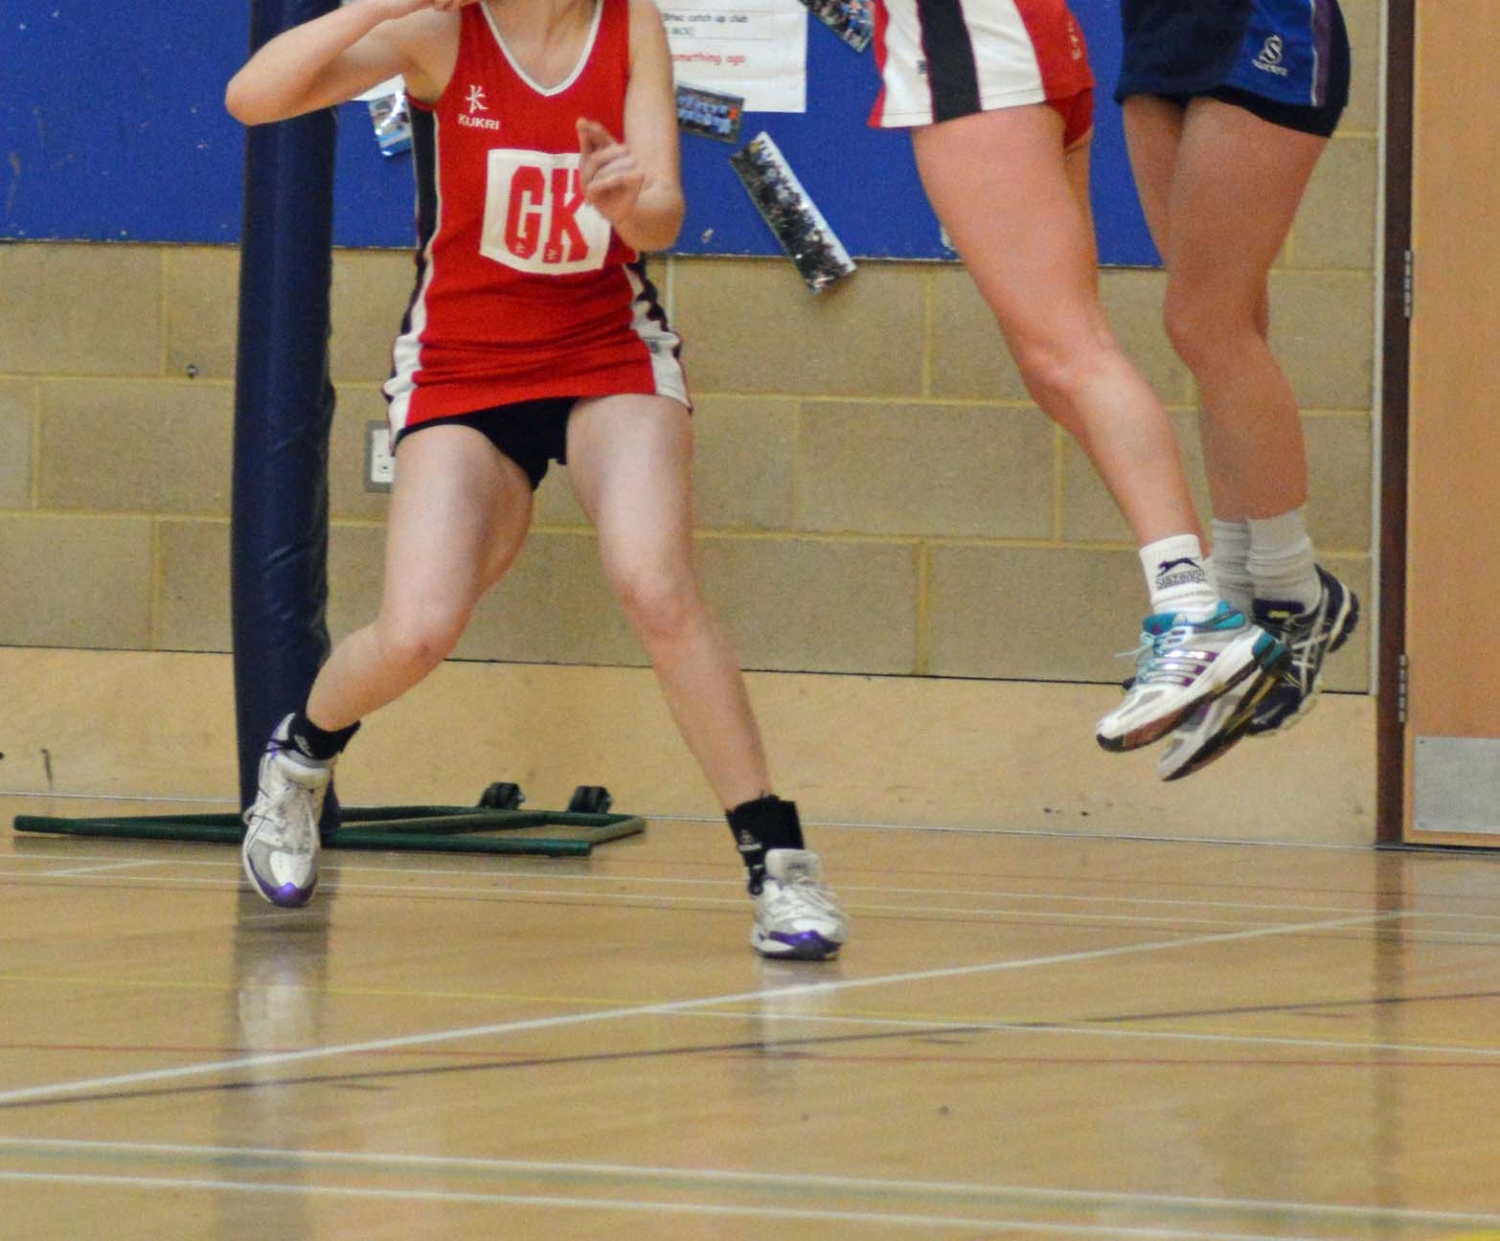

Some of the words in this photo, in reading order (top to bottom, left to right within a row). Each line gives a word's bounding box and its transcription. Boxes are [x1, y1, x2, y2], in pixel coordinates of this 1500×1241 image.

[672, 52, 722, 66] omething
[458, 113, 500, 131] KUKRI
[503, 165, 590, 264] GK
